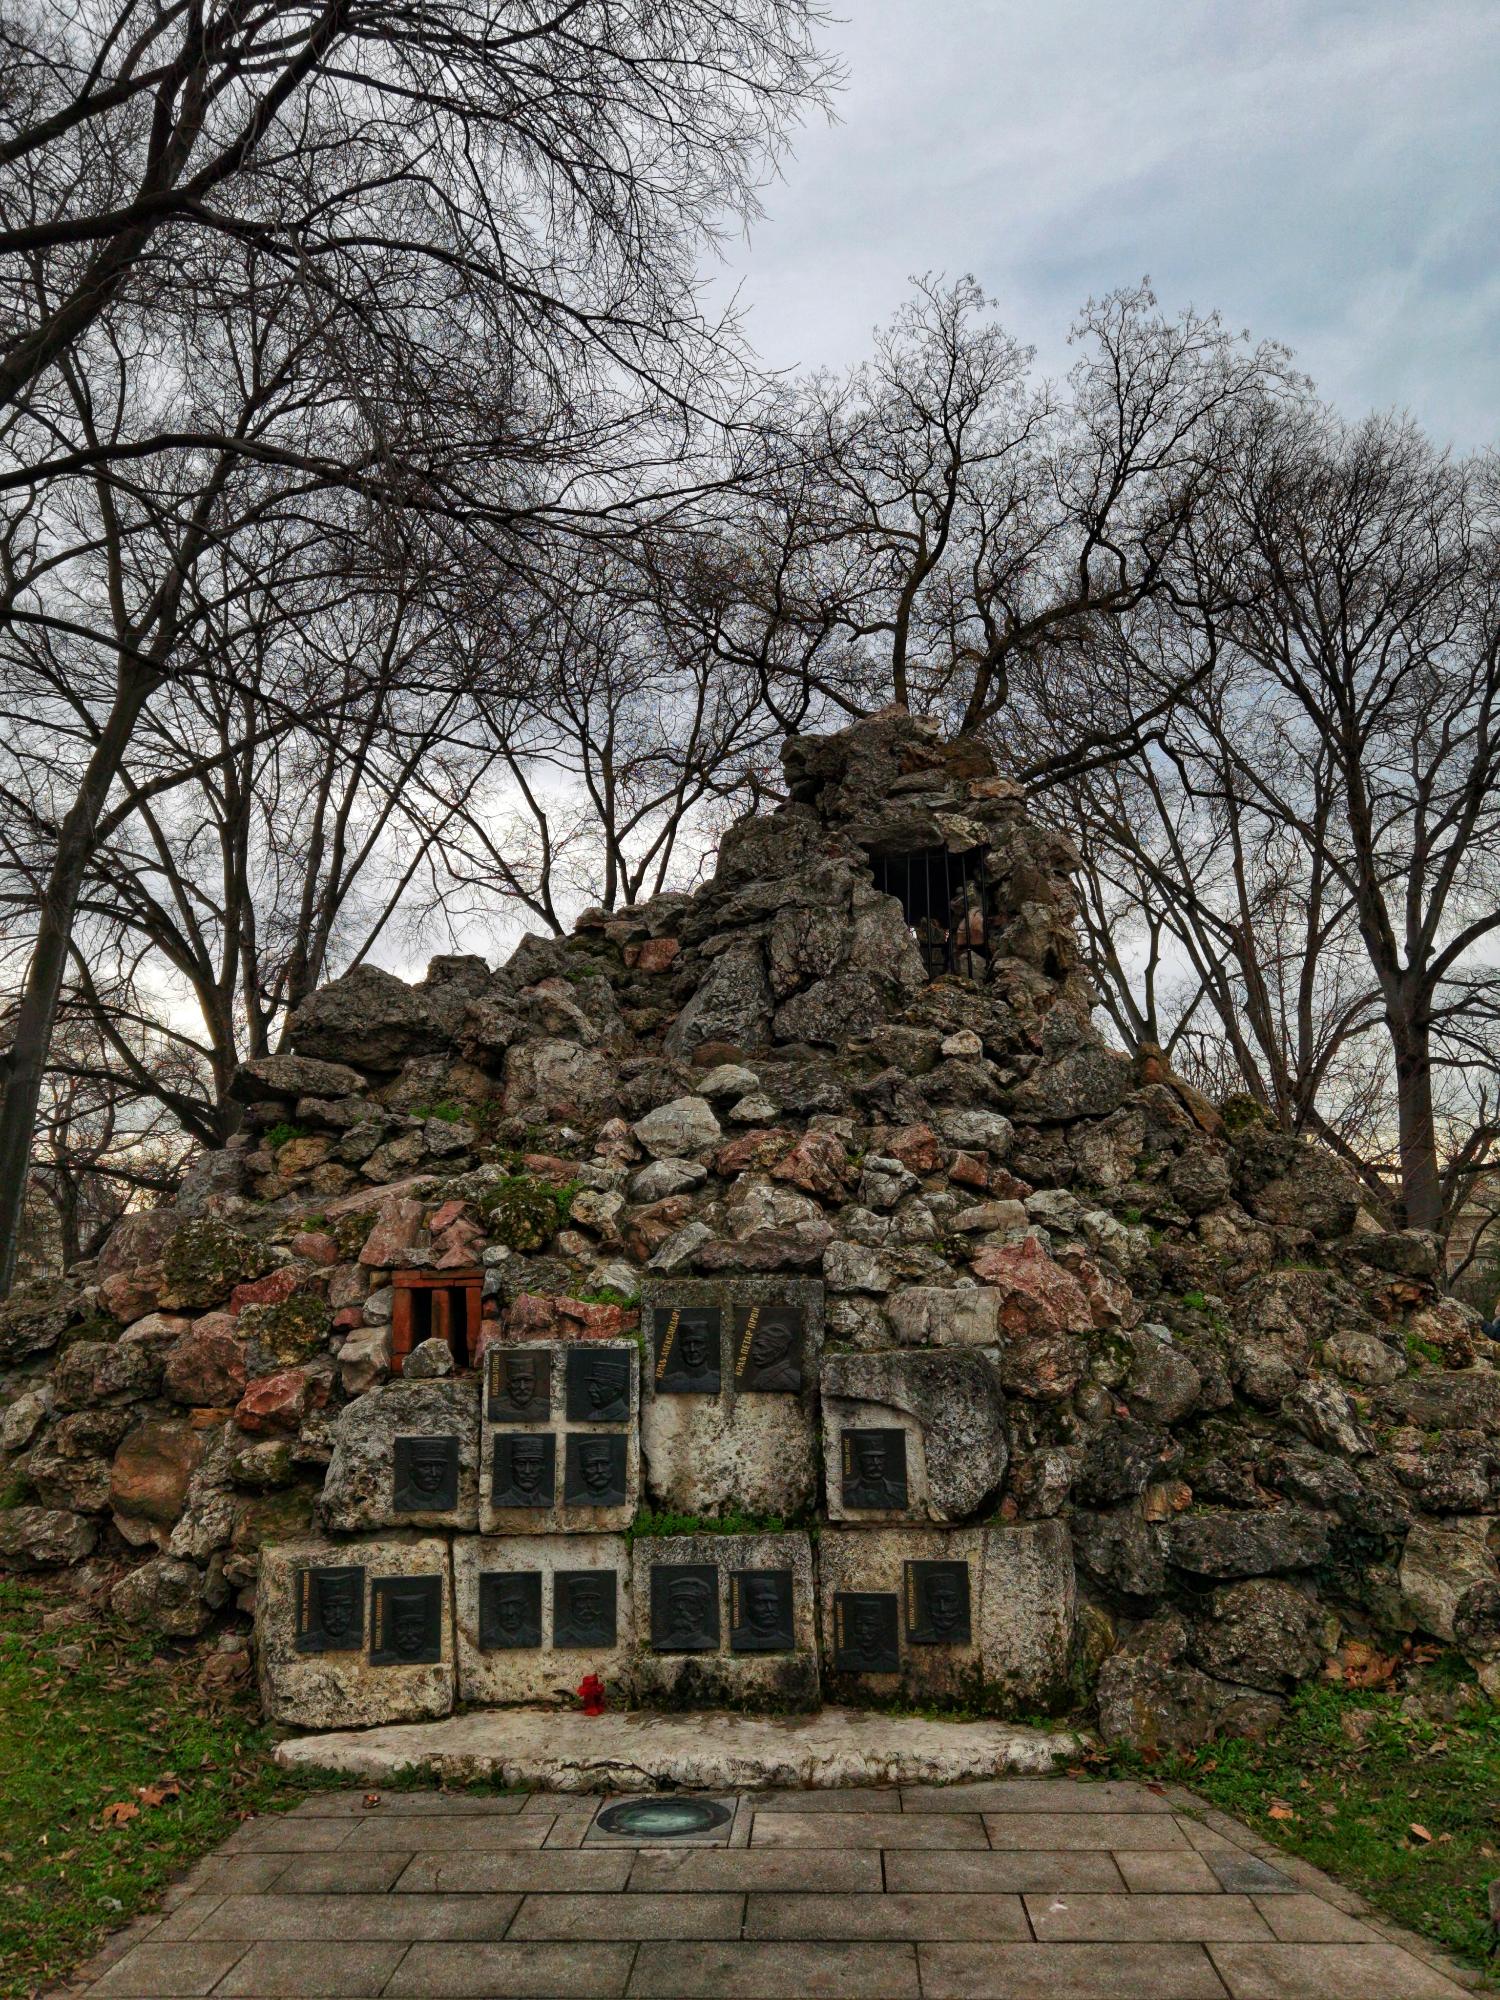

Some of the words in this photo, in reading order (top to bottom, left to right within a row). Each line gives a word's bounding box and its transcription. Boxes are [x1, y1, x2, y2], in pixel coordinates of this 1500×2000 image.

[660, 1312, 680, 1357] АЛЕКСАНДАР
[733, 1356, 747, 1377] КРАЉ
[740, 1330, 753, 1355] ПЕТАР
[747, 1307, 760, 1329] ПРВИ
[655, 1358, 668, 1378] КРАЉ
